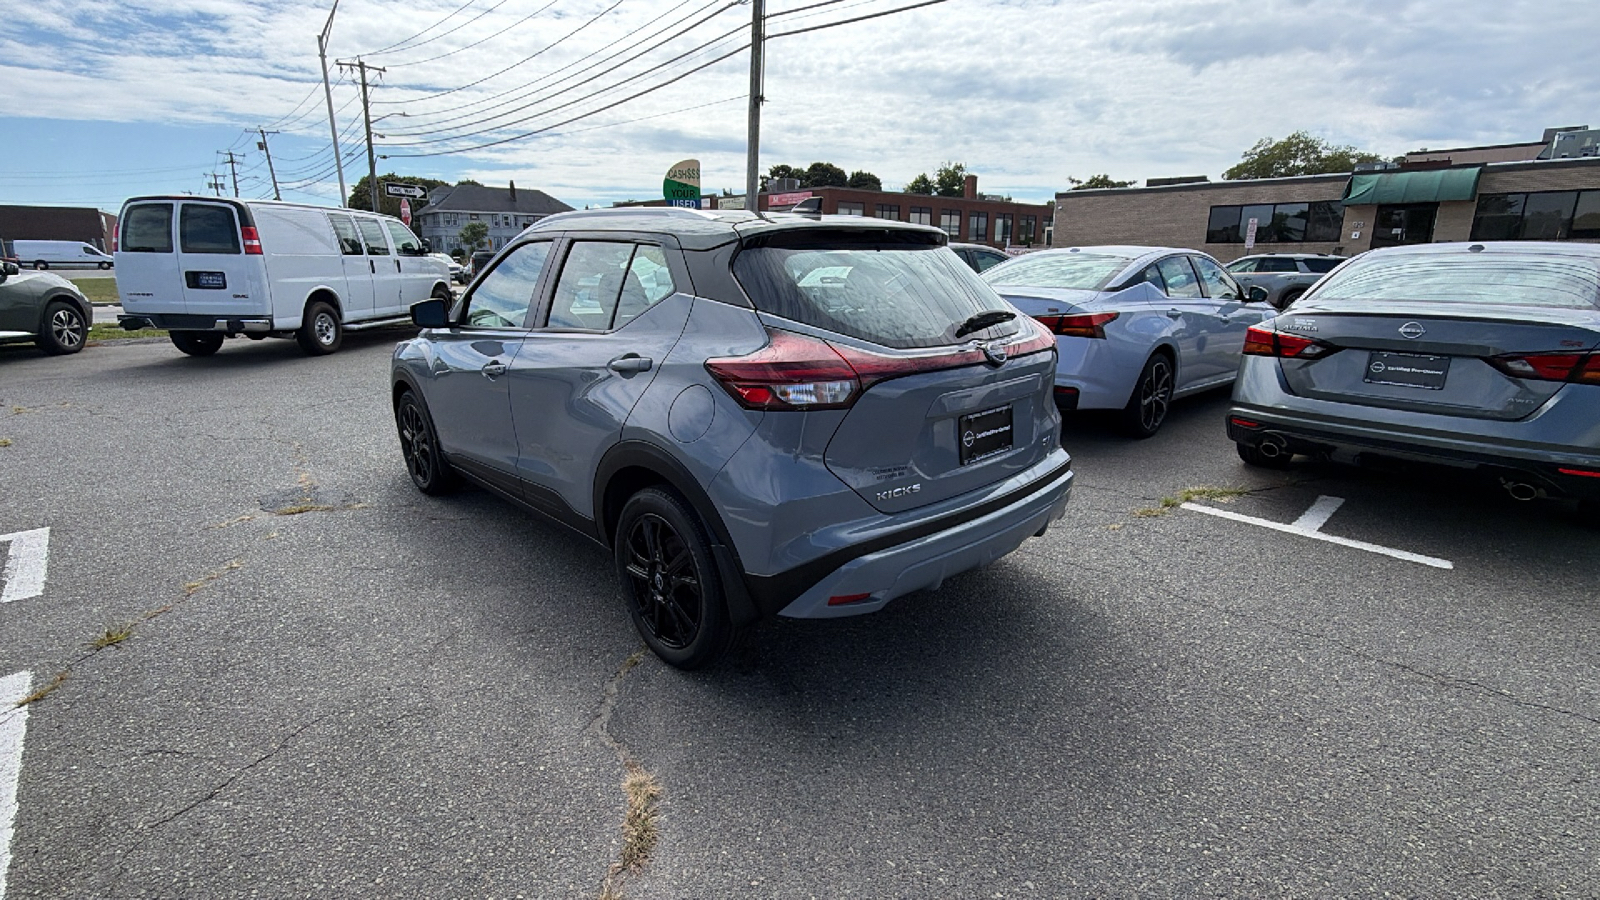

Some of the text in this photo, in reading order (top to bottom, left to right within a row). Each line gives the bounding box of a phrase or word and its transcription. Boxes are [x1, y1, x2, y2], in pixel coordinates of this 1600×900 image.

[668, 168, 700, 179] CASH$$$
[671, 189, 696, 198] YOUR
[672, 199, 696, 209] USED
[1283, 324, 1318, 332] ALTIMA
[876, 483, 921, 501] KICKS
